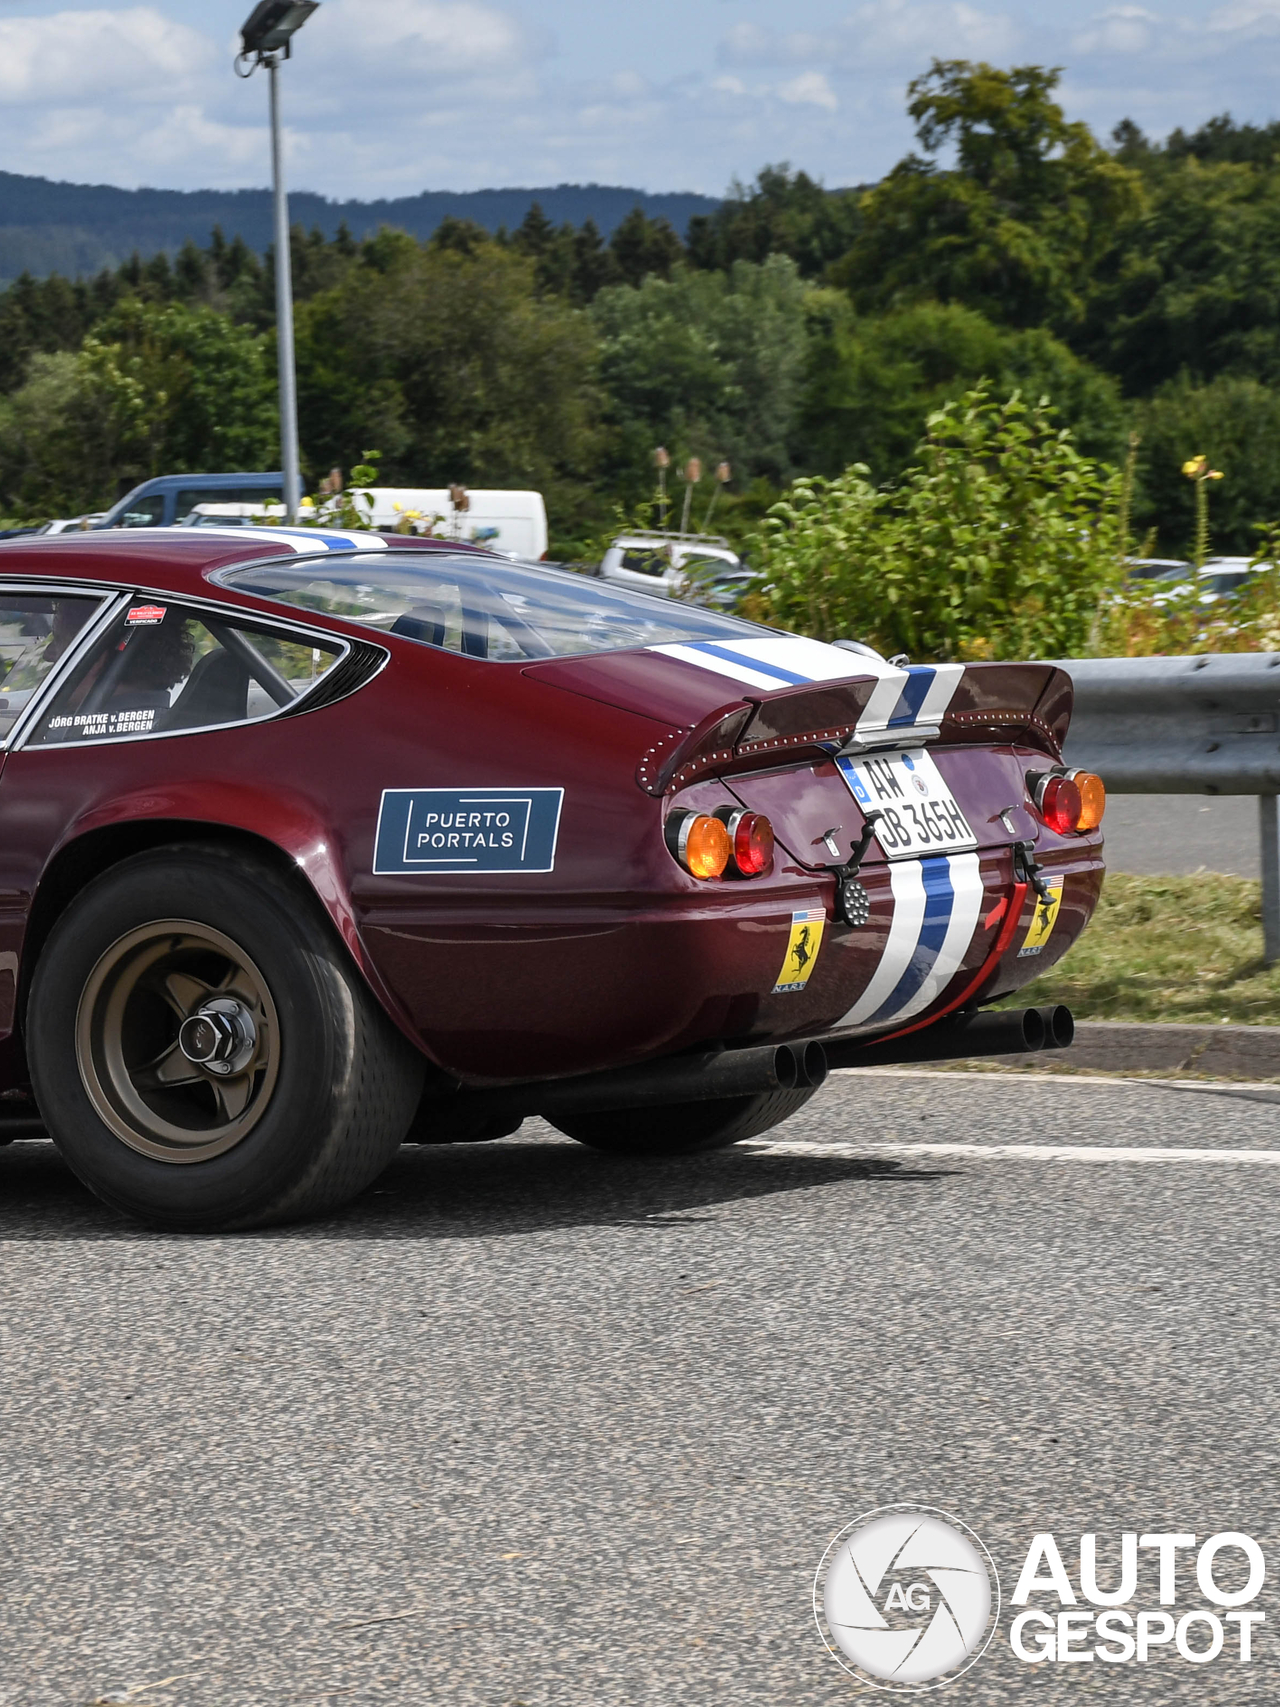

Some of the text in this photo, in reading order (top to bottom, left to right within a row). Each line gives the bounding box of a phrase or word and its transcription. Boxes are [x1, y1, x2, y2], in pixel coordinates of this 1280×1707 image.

[48, 716, 72, 728] JÖRG
[74, 713, 109, 726] BRATKE
[82, 724, 106, 735] ANJA
[862, 758, 905, 800] AW
[854, 786, 865, 798] D
[426, 812, 510, 828] PUERTO
[902, 799, 972, 844] 365H
[417, 832, 514, 848] PORTALS
